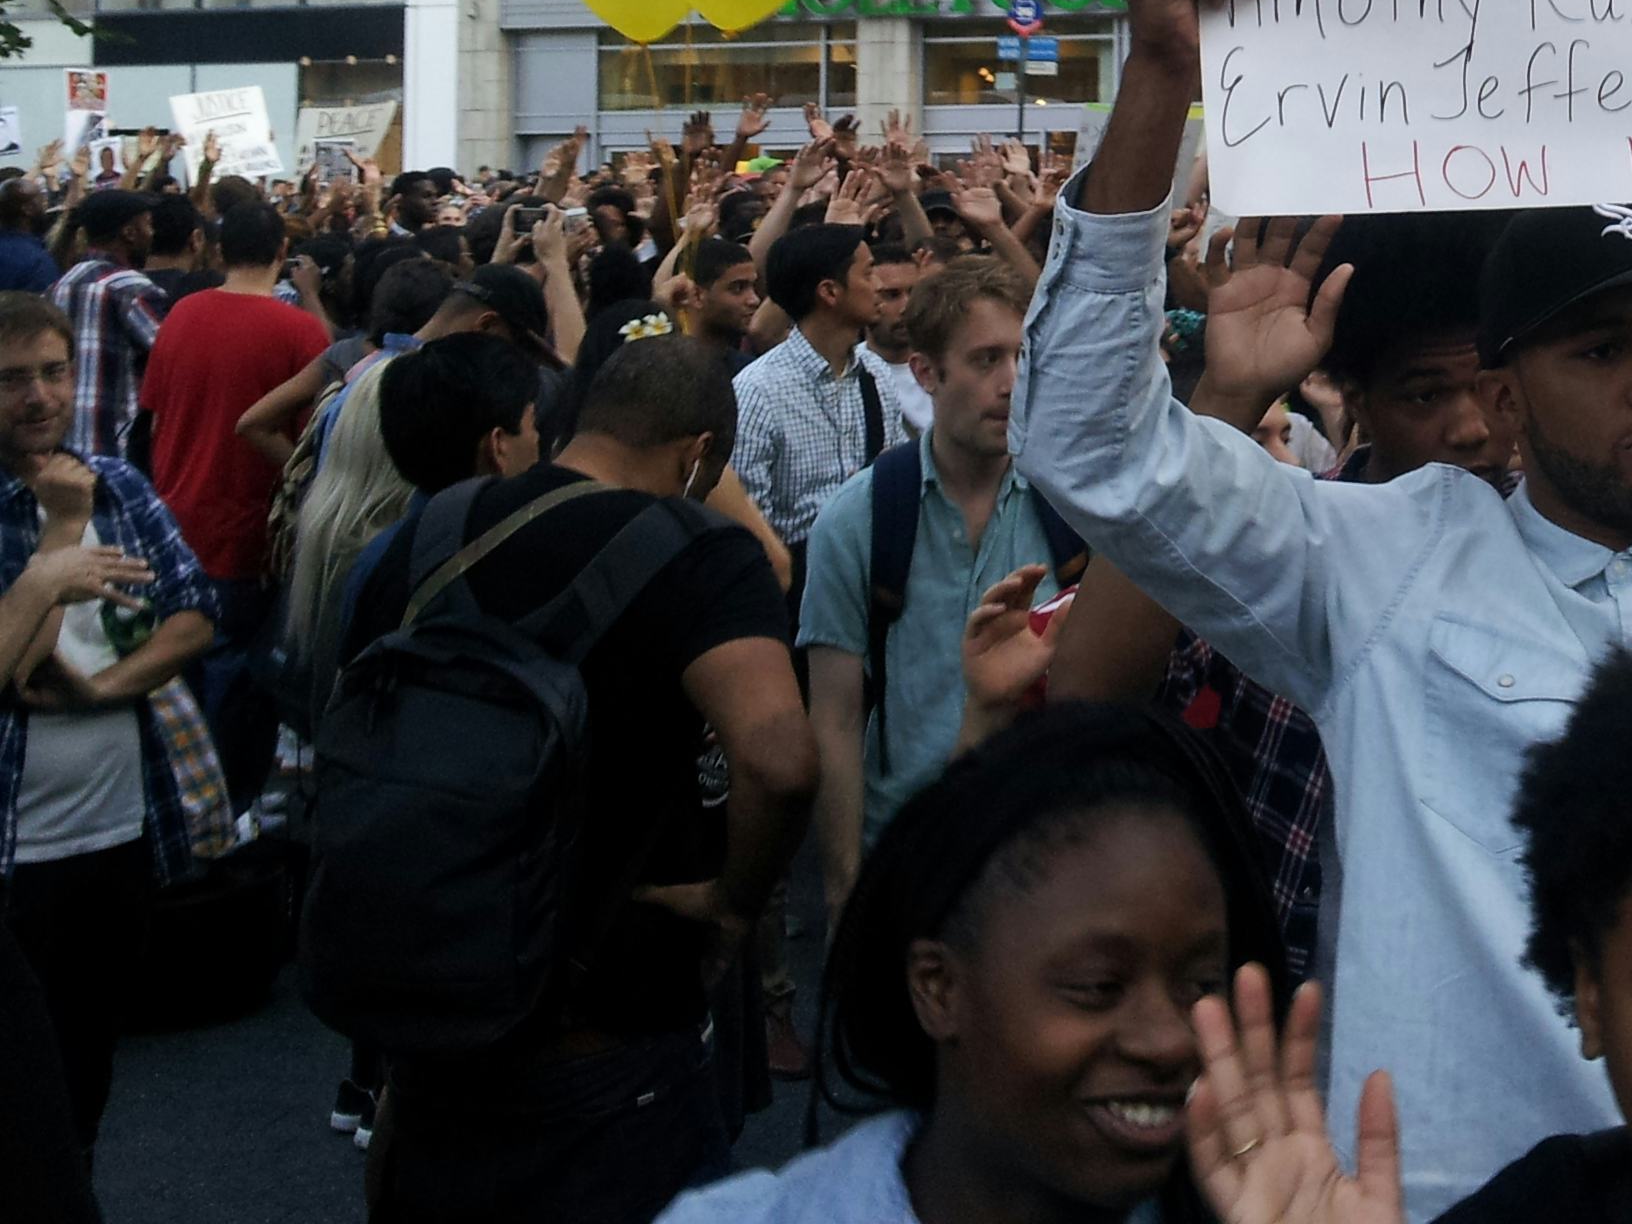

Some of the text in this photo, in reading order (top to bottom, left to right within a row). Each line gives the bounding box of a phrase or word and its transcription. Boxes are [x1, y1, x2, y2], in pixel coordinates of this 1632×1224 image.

[316, 108, 384, 135] PEACE
[1221, 46, 1408, 147] Ervin
[1361, 139, 1549, 208] HOW
